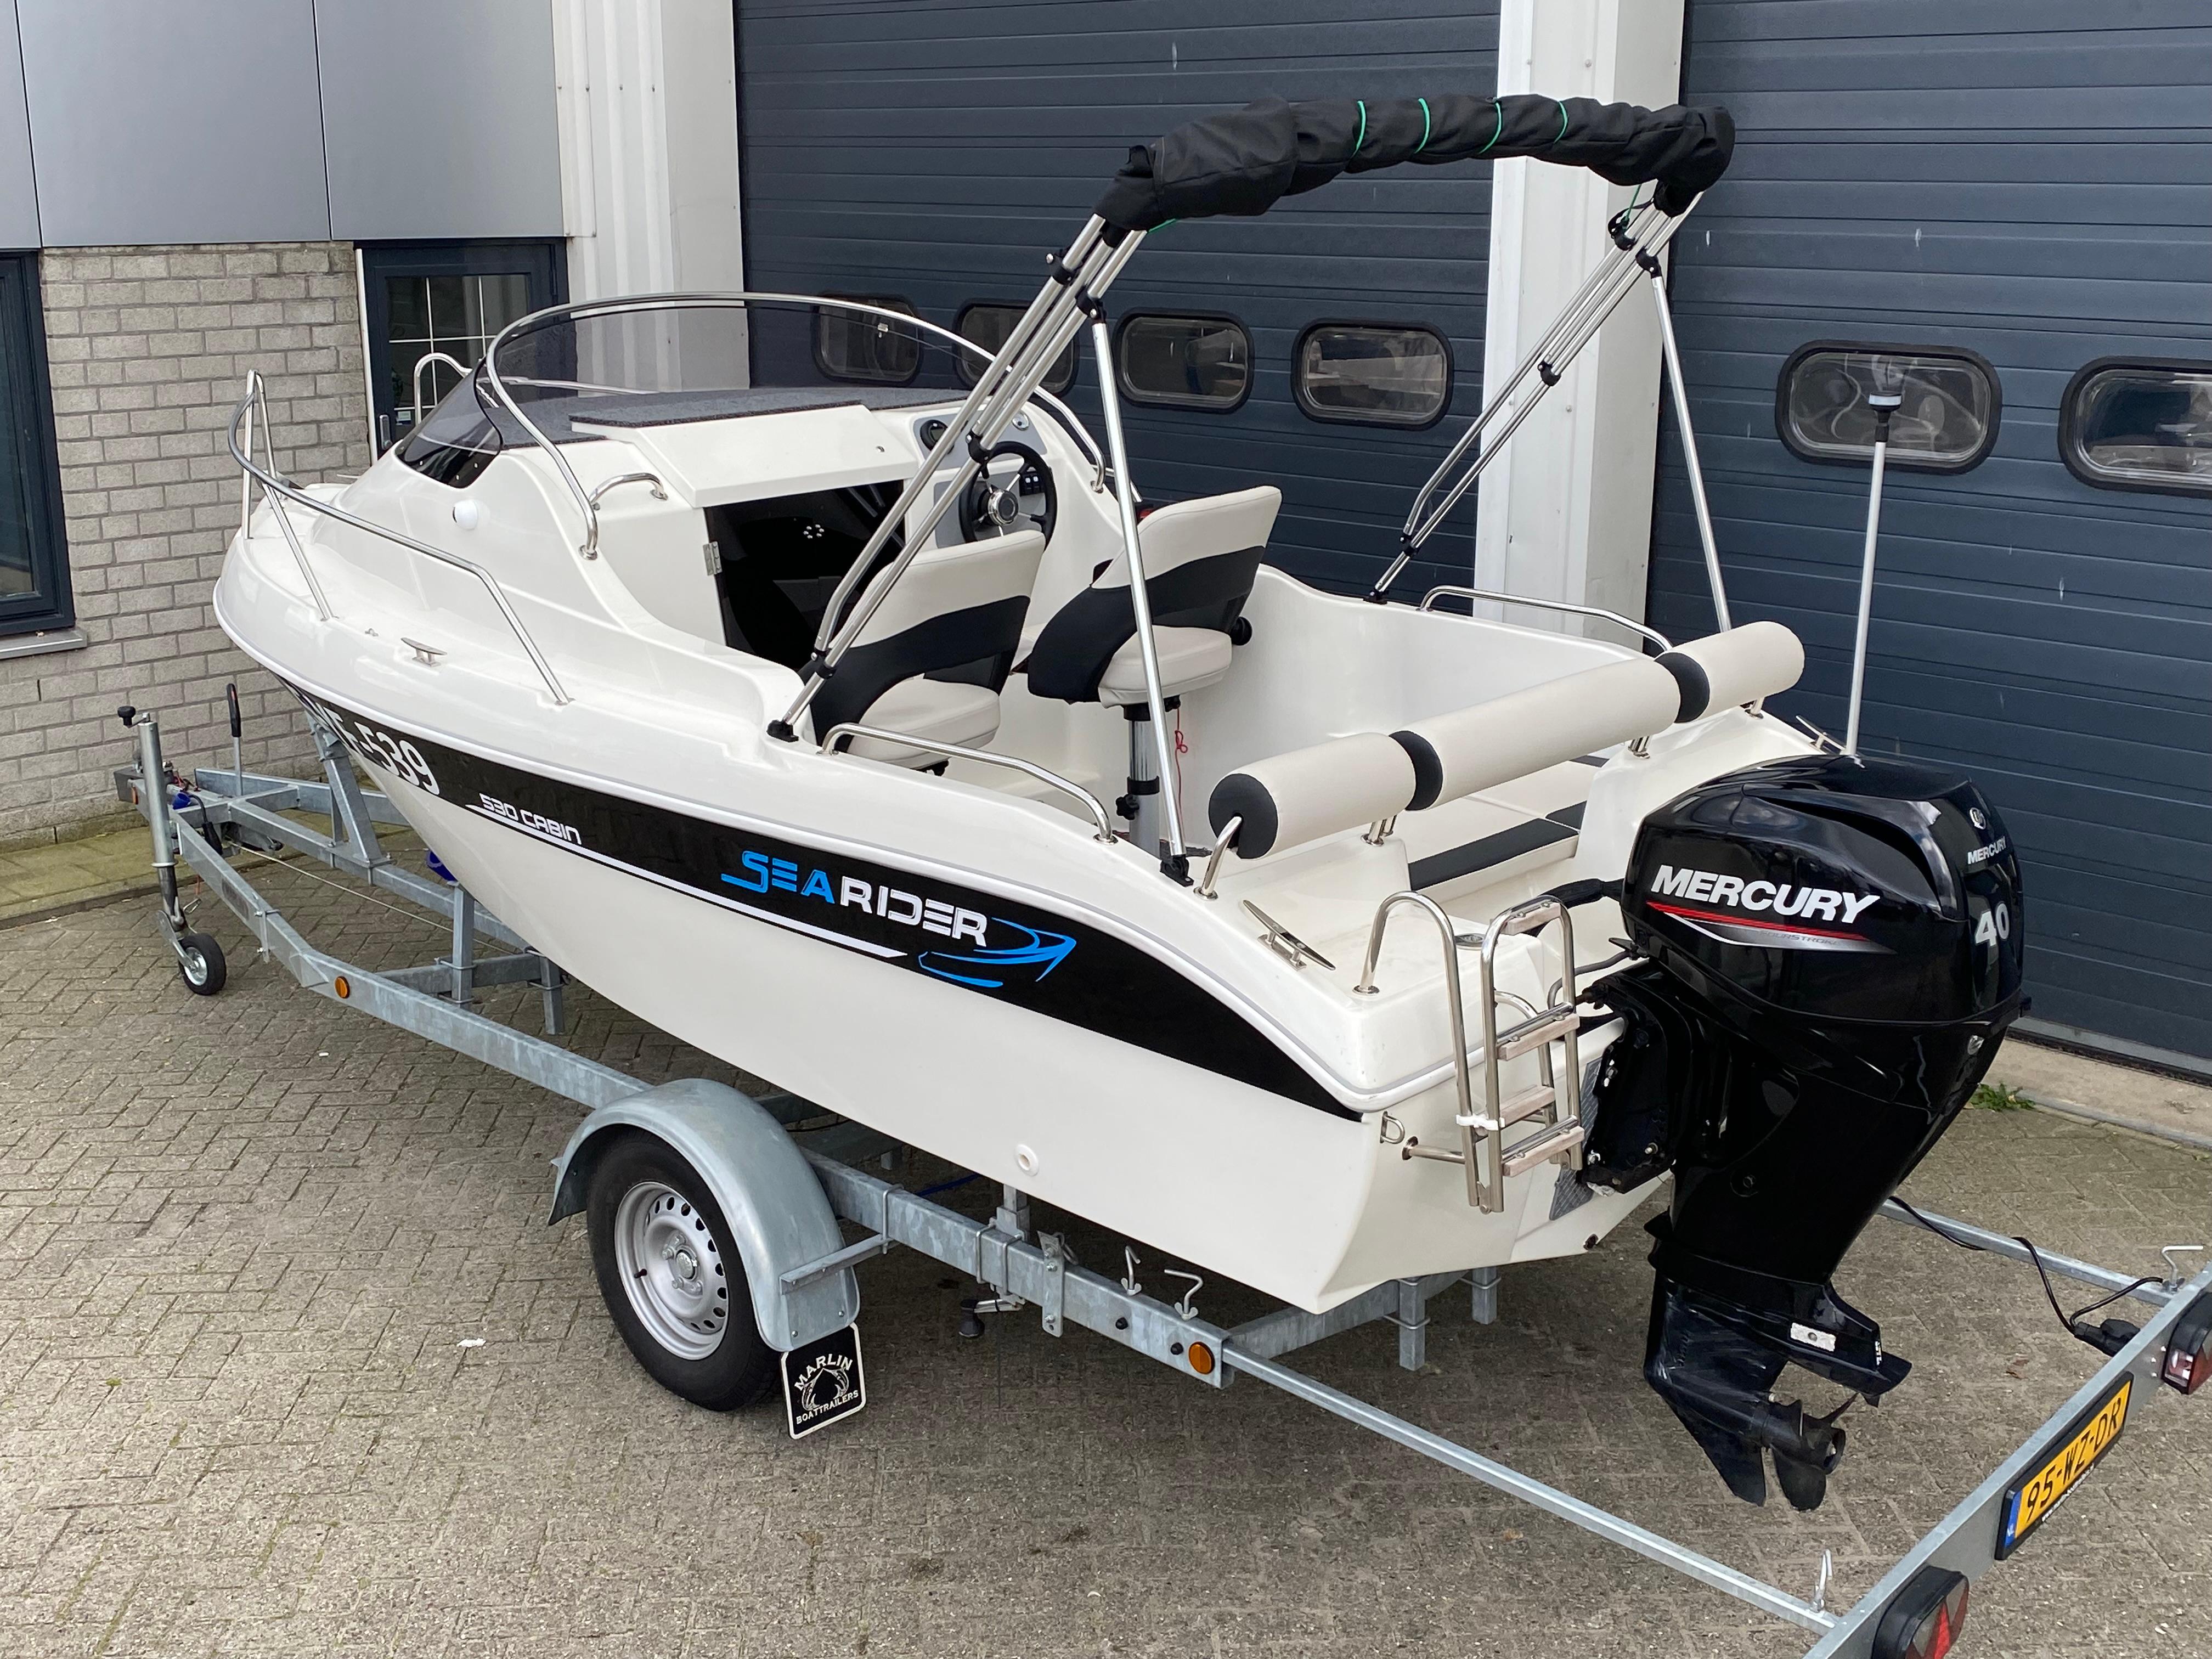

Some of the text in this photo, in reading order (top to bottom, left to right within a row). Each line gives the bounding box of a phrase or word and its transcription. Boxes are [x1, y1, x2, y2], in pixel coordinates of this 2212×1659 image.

[479, 793, 582, 845] 530 CABIN
[1967, 836, 2006, 865] MERCURY
[1651, 865, 1881, 924] MERCURY
[1975, 902, 2010, 947] 40
[794, 1353, 853, 1391] MARLIN
[796, 1390, 859, 1425] BOATTRAILERS
